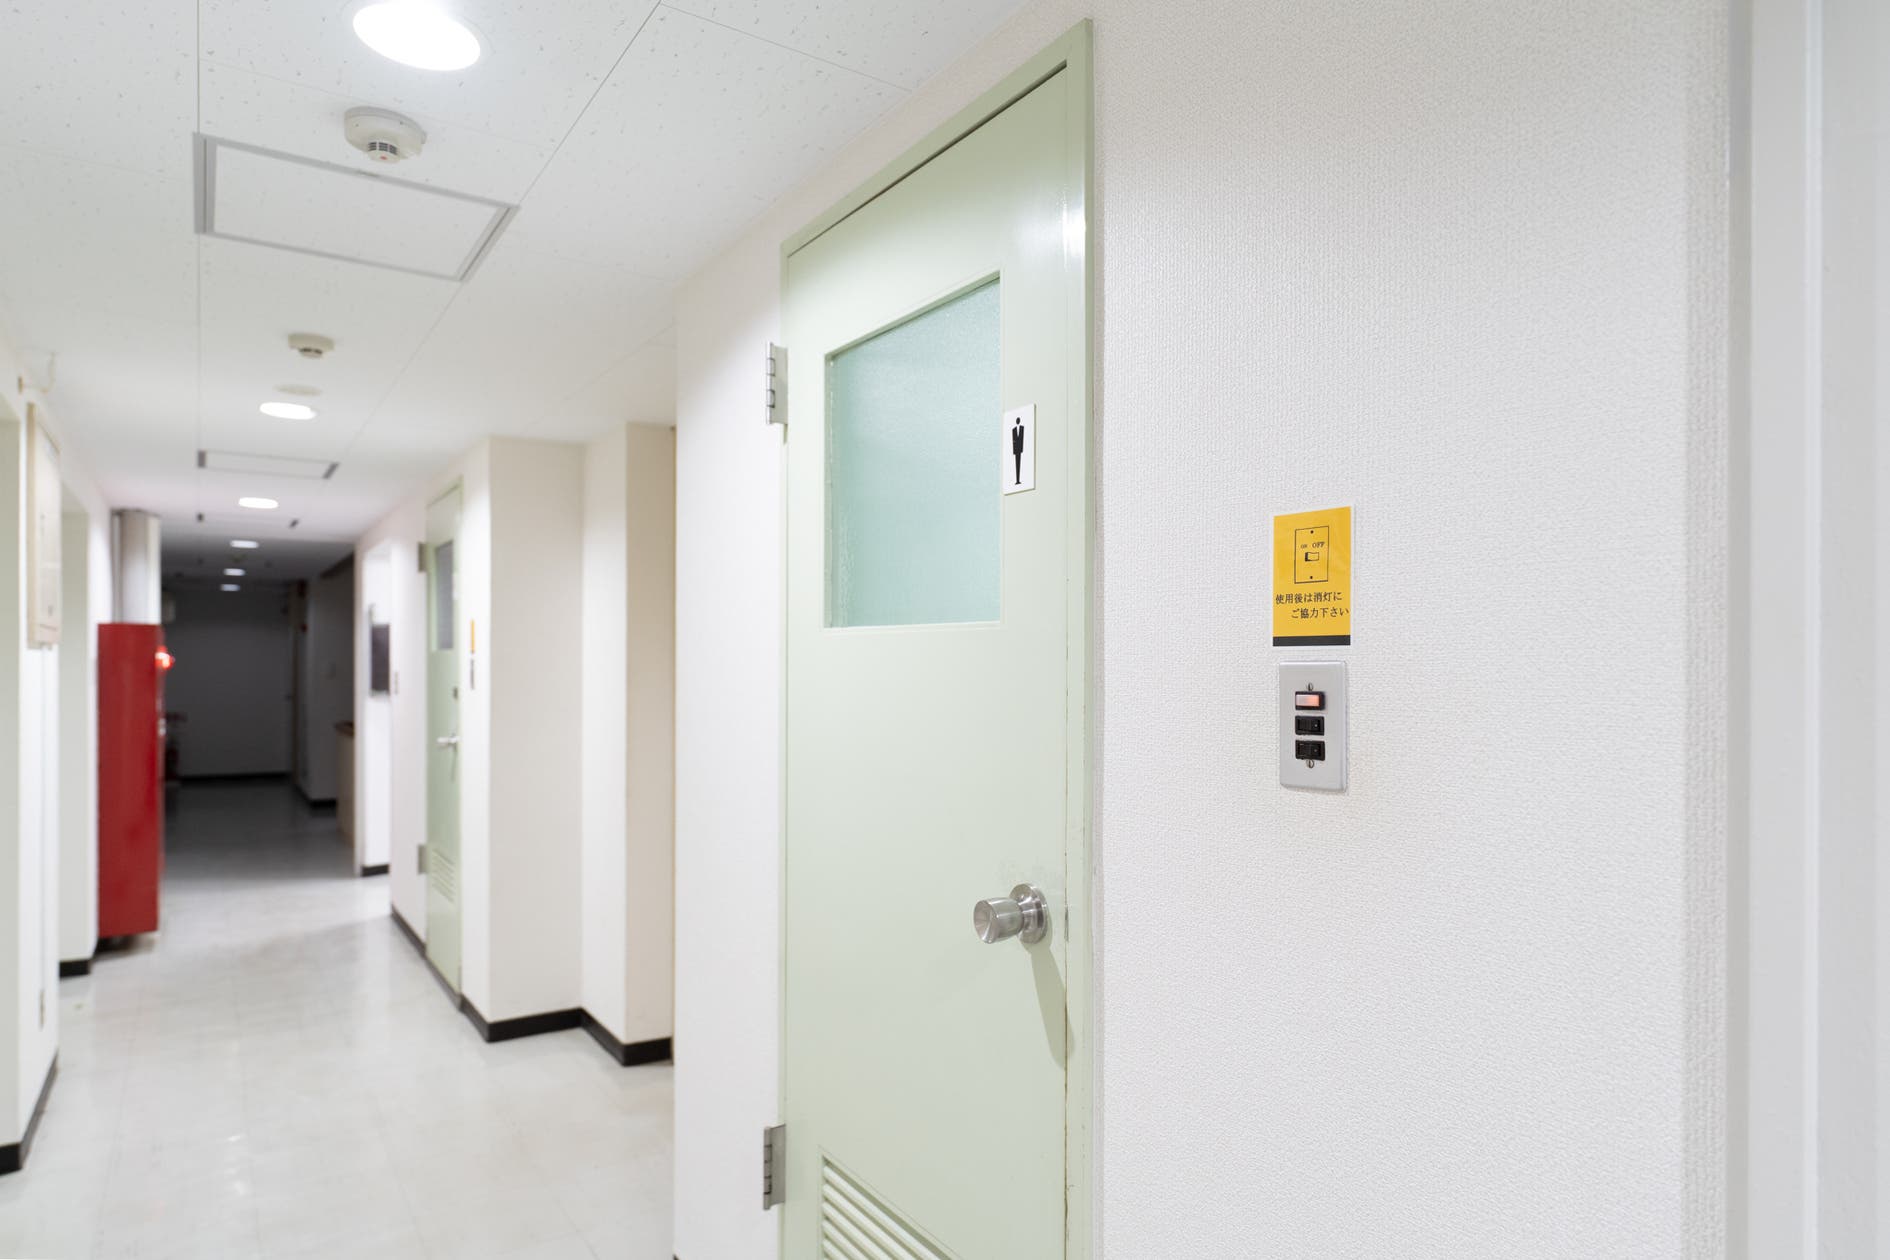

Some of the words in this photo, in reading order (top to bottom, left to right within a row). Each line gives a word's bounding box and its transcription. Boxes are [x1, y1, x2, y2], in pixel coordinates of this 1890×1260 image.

[1275, 591, 1342, 604] 使用後は消灯に
[1291, 607, 1349, 619] ご協力下さい
